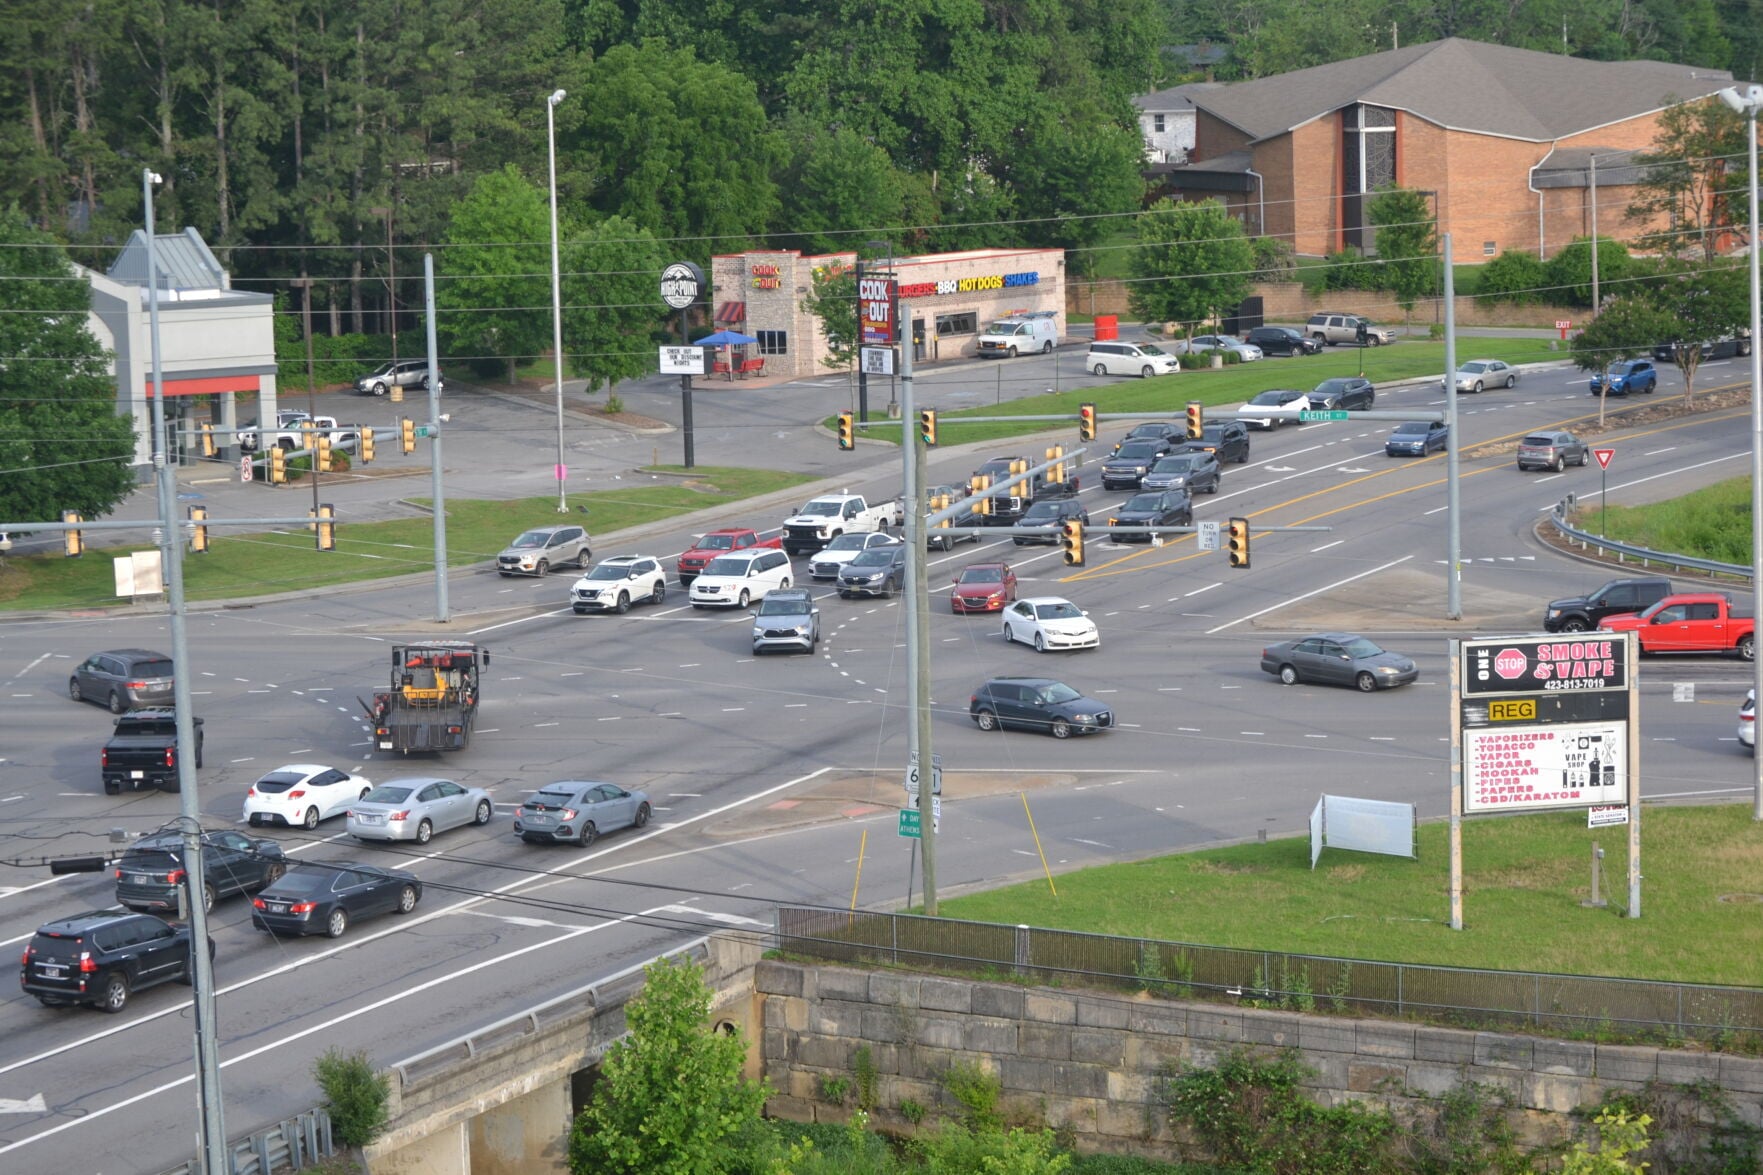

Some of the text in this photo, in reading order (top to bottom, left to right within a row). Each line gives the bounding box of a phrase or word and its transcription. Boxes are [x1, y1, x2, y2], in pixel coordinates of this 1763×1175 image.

[860, 280, 888, 300] COOK
[898, 272, 1039, 298] URGERS BBQ HOT DOGS SHAKES
[870, 302, 889, 321] OUT
[1556, 320, 1570, 328] EXIT
[1304, 411, 1330, 420] KEITH
[1537, 641, 1612, 661] SMOKE
[1478, 649, 1489, 680] ONE
[1497, 658, 1524, 670] STOP
[1544, 678, 1605, 690] 423-813-7019
[1492, 703, 1533, 718] REG
[1565, 753, 1586, 761] VAPE
